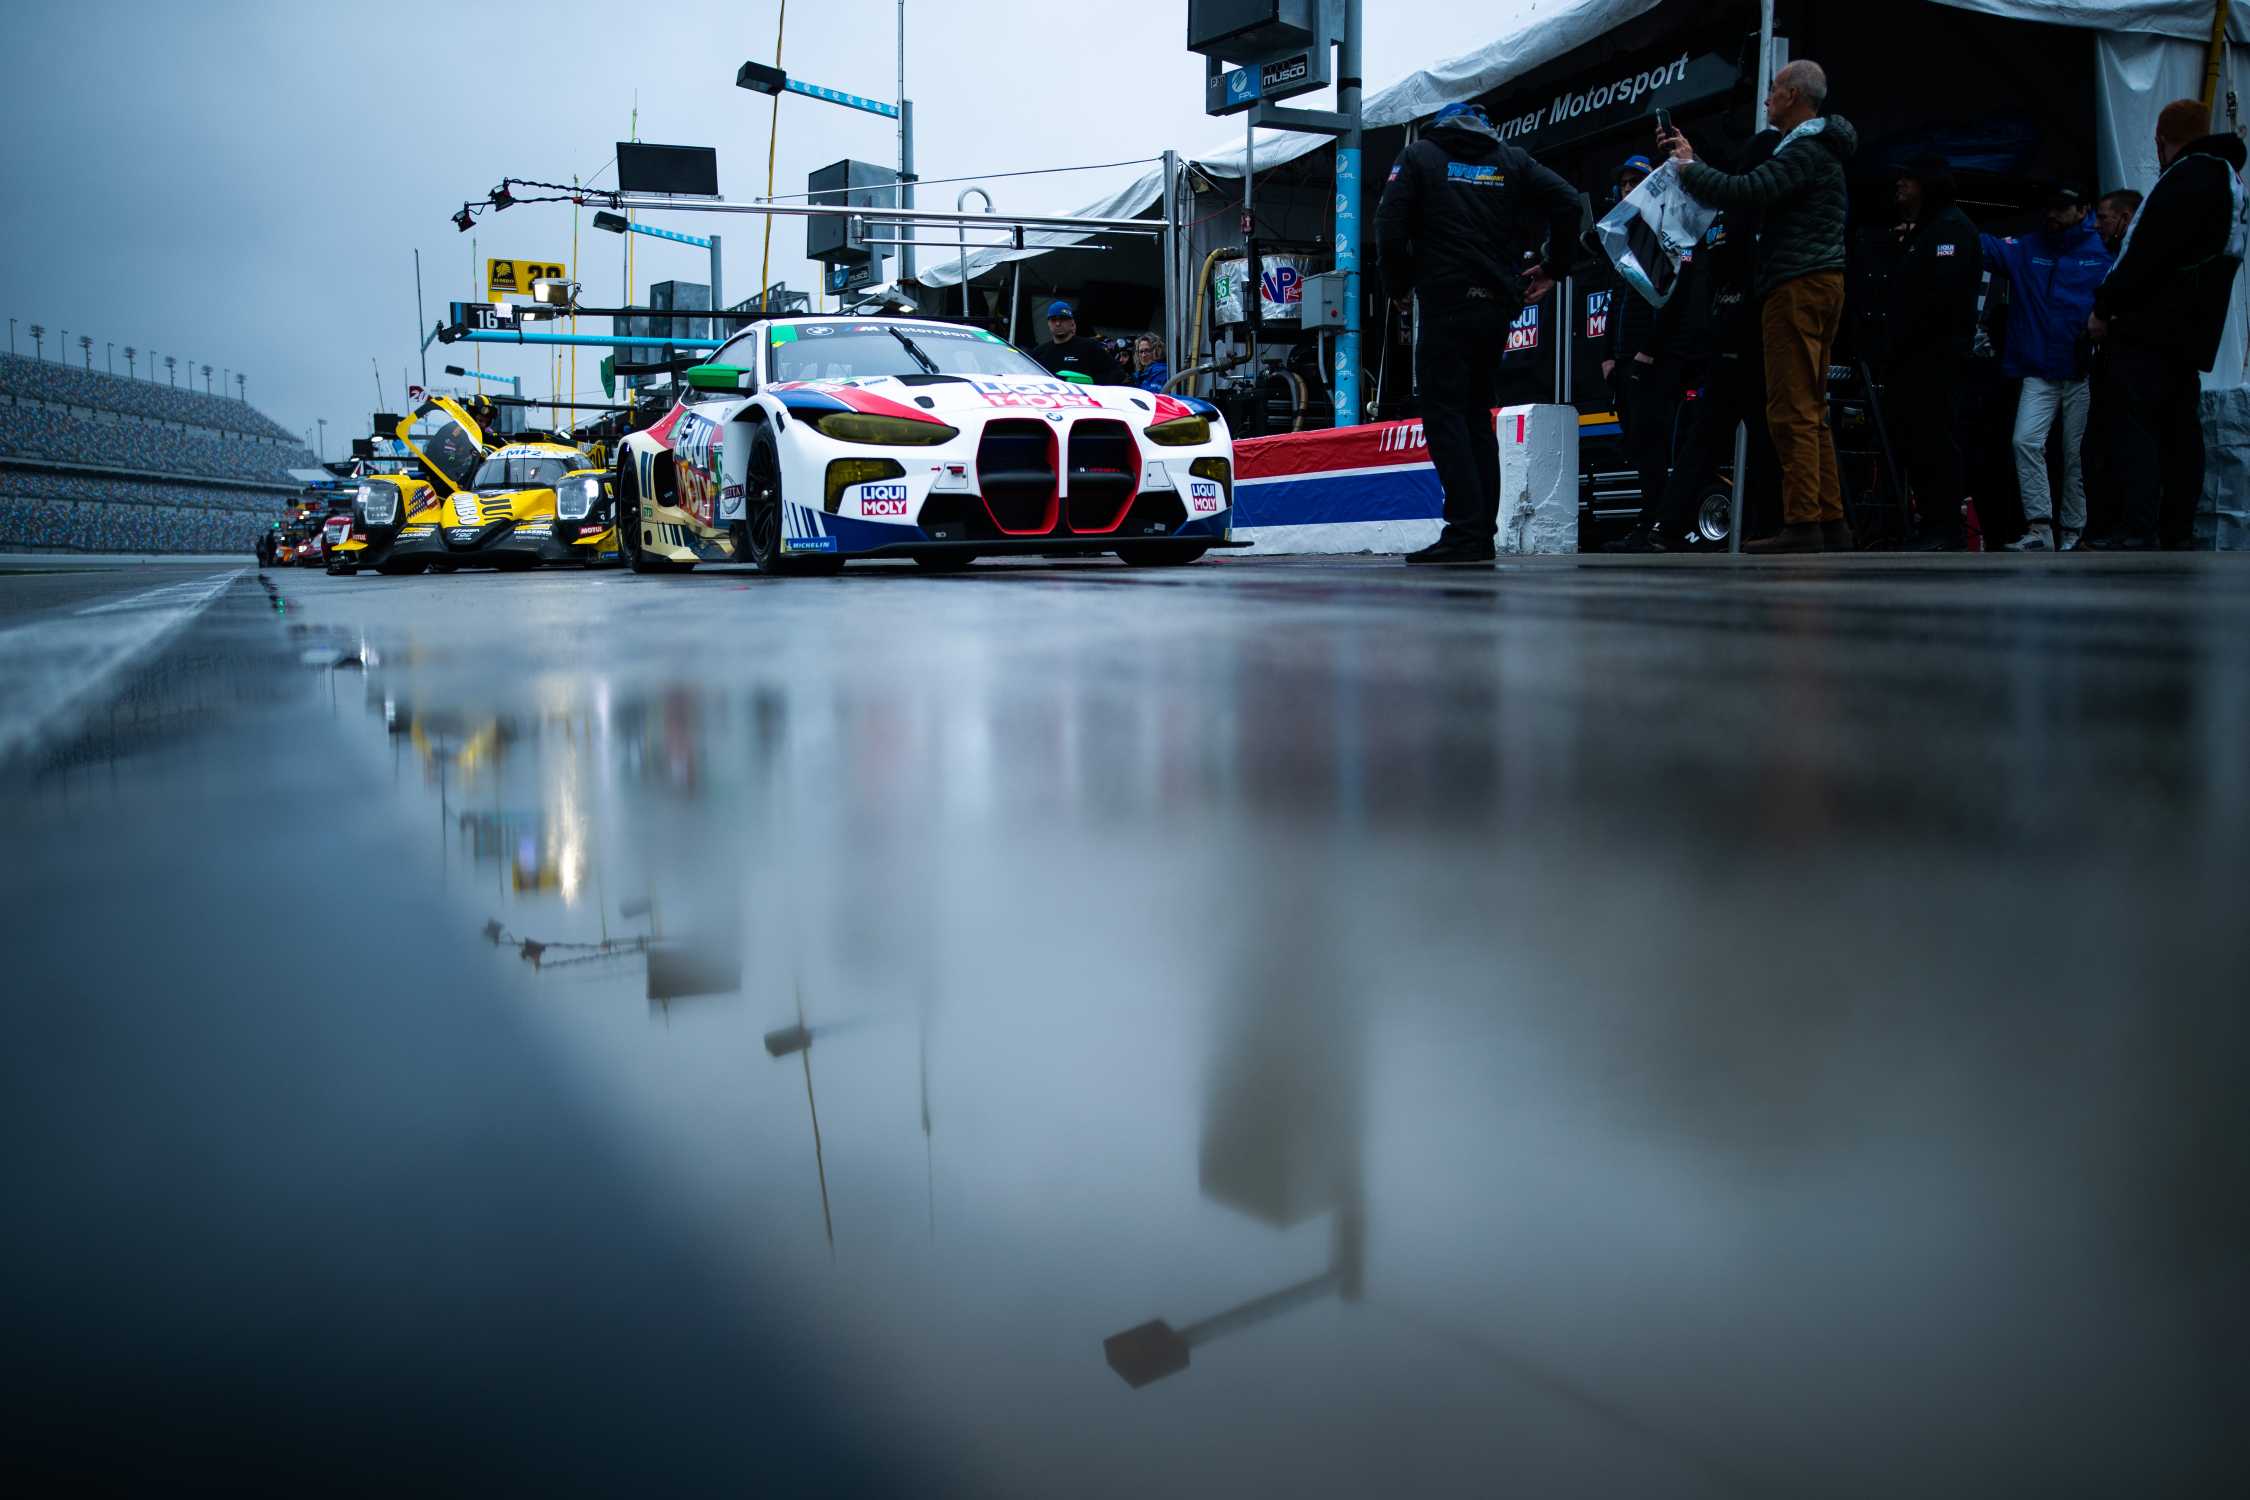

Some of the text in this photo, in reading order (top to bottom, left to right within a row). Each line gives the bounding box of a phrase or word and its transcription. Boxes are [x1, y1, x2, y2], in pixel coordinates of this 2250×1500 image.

[1495, 51, 1689, 143] urner Motorsport
[1217, 280, 1227, 298] 96
[1263, 267, 1297, 304] VP
[477, 310, 498, 328] 16
[976, 382, 1084, 396] LIQUI
[986, 394, 1098, 408] MOLY
[863, 487, 905, 501] LIQUI
[1192, 485, 1215, 497] LIQUI
[863, 501, 906, 515] MOLY
[1194, 498, 1216, 511] MOLY
[581, 526, 603, 535] MOTUL
[793, 541, 831, 550] MICHELIN
